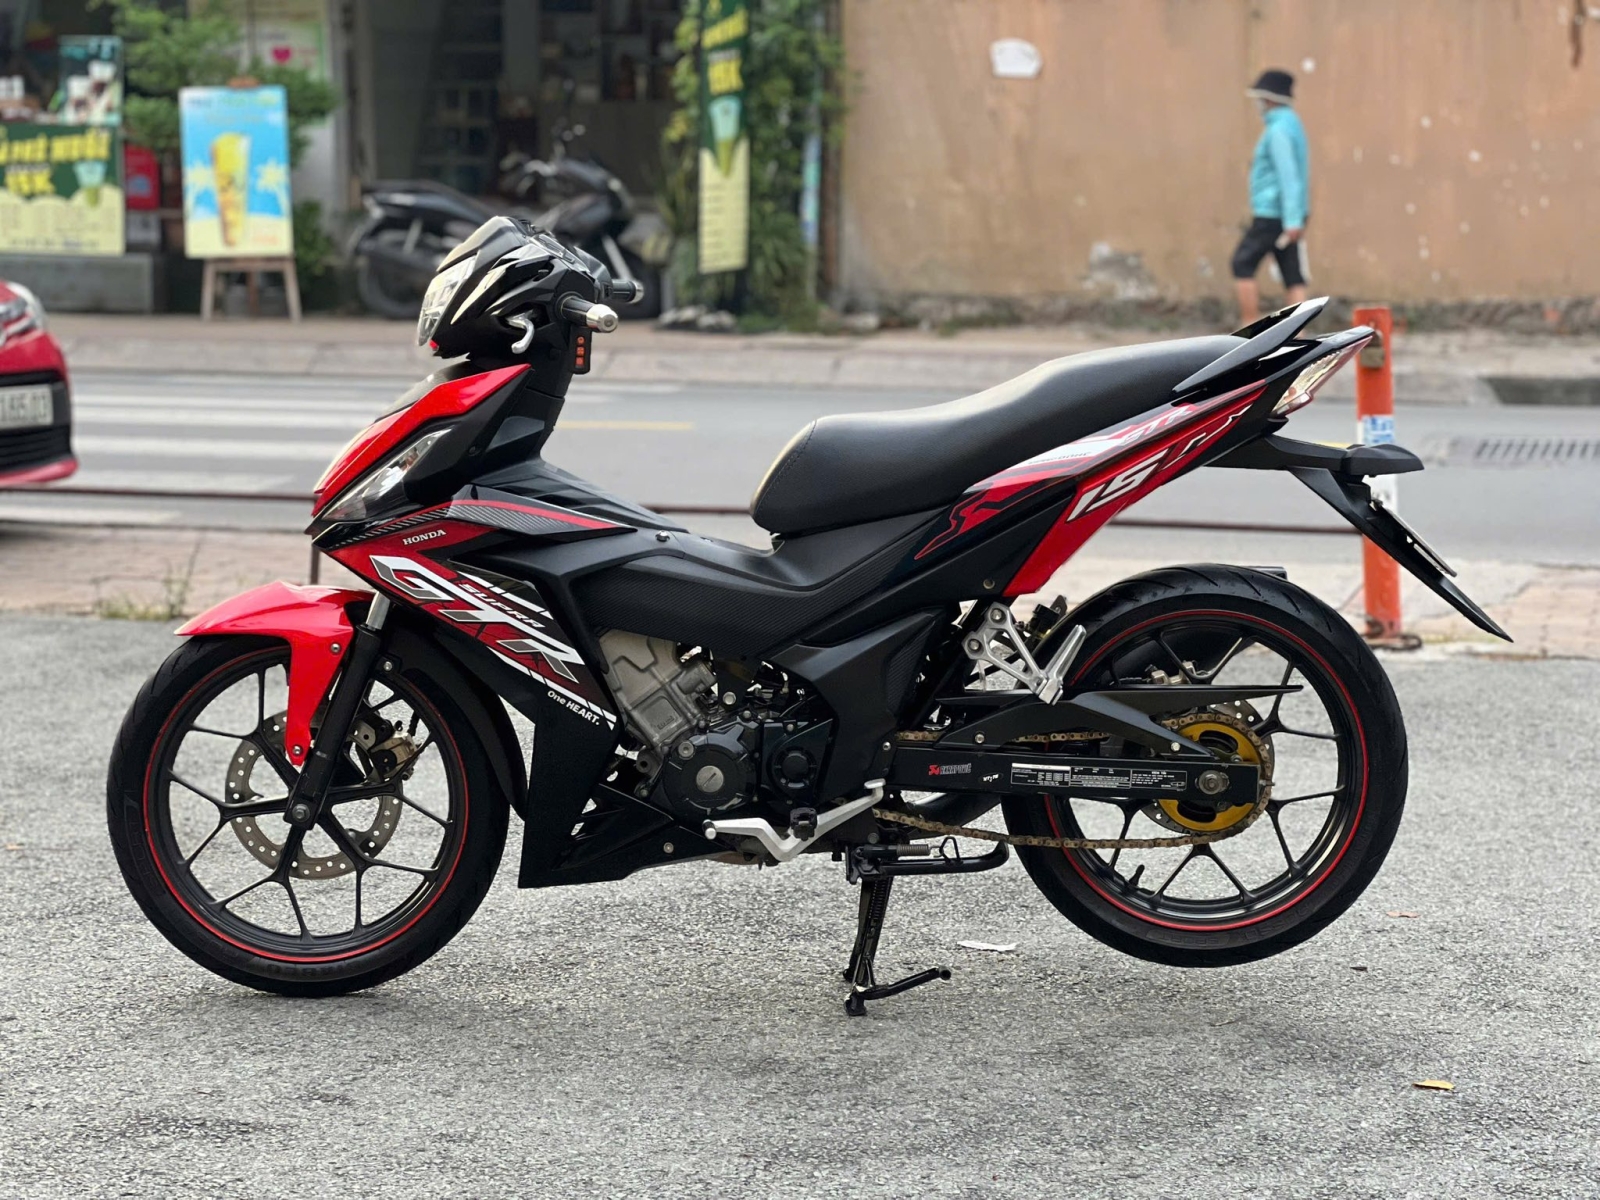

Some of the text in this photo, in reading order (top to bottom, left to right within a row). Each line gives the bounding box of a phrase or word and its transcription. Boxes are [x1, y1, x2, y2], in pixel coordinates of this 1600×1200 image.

[402, 528, 447, 546] HONDA
[459, 582, 546, 629] SUPRA
[547, 689, 568, 706] One
